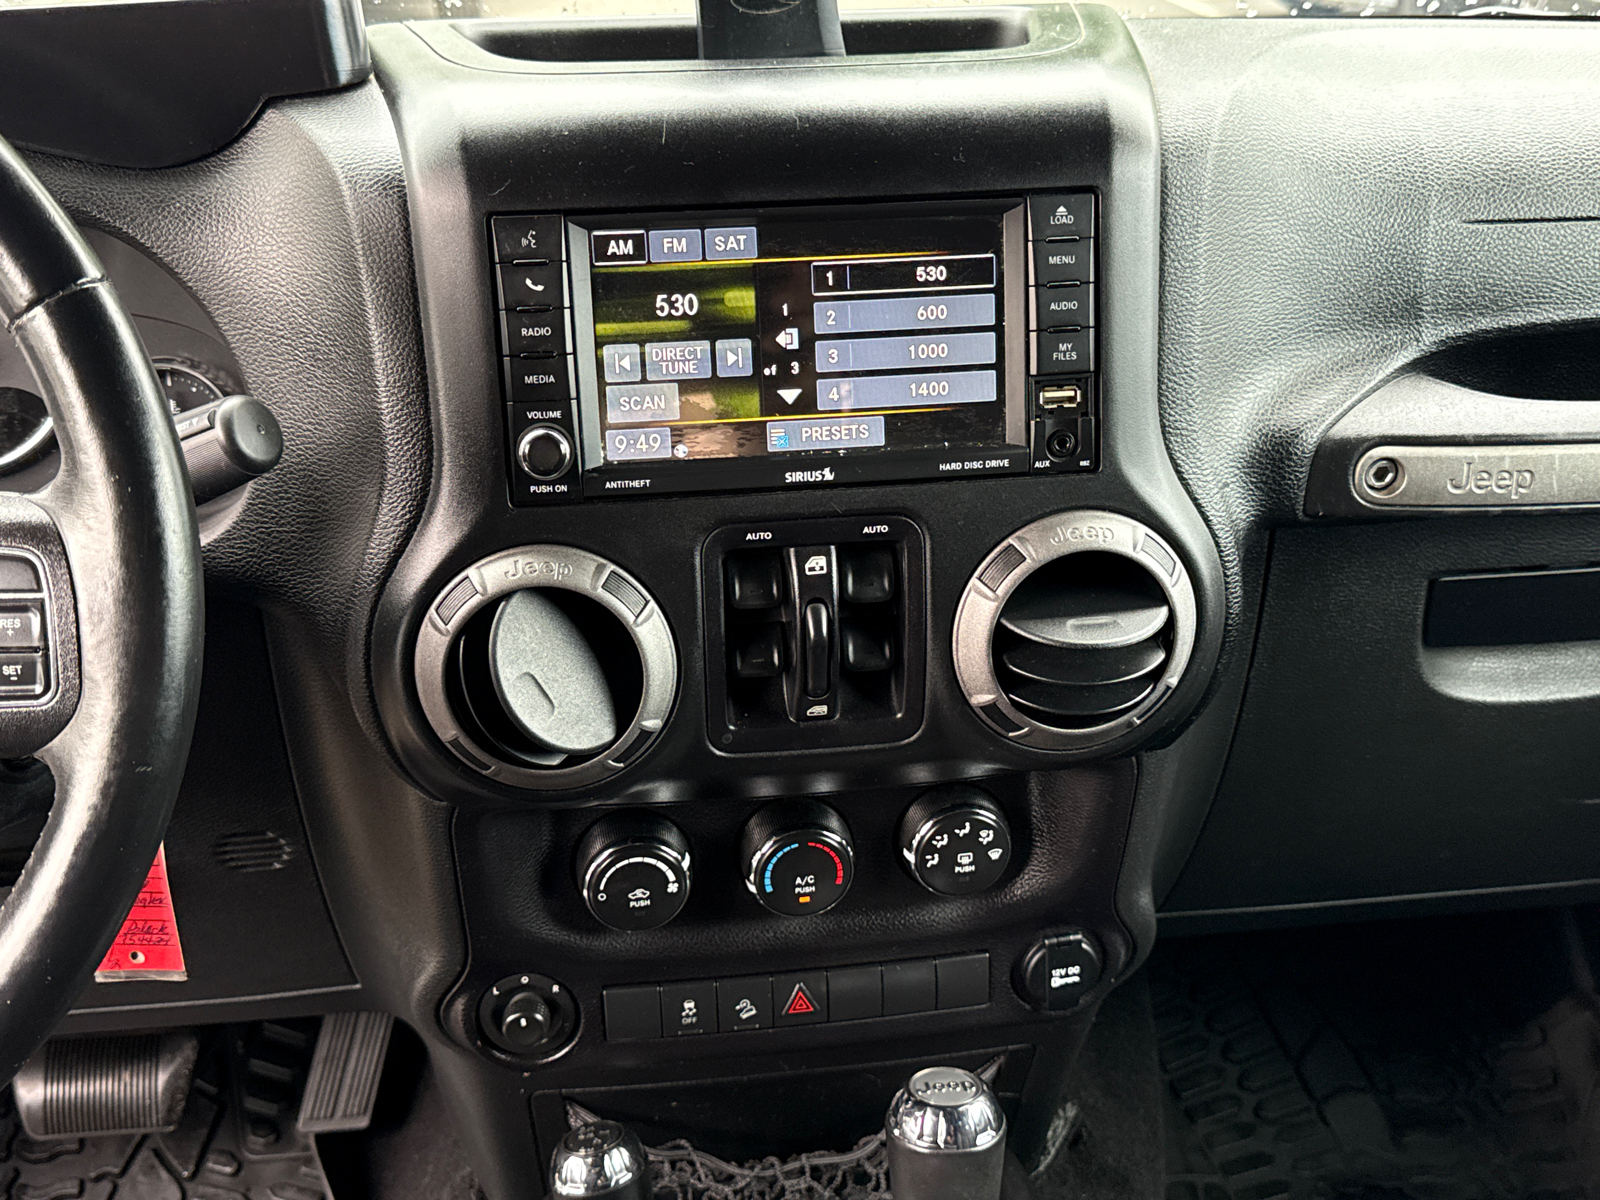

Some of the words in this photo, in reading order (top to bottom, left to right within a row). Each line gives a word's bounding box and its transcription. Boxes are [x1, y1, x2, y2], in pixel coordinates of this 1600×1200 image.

[1050, 215, 1074, 225] LOAD
[606, 239, 634, 256] AM
[662, 237, 687, 254] FM
[714, 234, 747, 251] SAT
[1048, 255, 1076, 265] MENU
[825, 270, 834, 286] 1
[915, 265, 947, 282] 530
[655, 293, 699, 317] 530
[782, 303, 788, 317] 1
[1049, 300, 1078, 310] AUDIO
[826, 309, 836, 325] 2
[917, 304, 947, 321] 600
[521, 327, 552, 336] RADIO
[652, 347, 703, 361] DIRECT
[908, 343, 949, 360] 1000
[1058, 343, 1073, 352] MY
[828, 348, 839, 364] 3
[1053, 351, 1077, 361] FILES
[659, 360, 699, 375] TUNE
[763, 364, 777, 376] of
[790, 361, 800, 375] 3
[524, 375, 556, 384] MEDIA
[828, 386, 840, 402] 4
[909, 381, 949, 397] 1400
[619, 394, 666, 412] SCAN
[526, 410, 562, 419] VOLUME
[801, 423, 870, 443] PRESETS
[614, 433, 662, 454] 9:49
[939, 463, 962, 471] HARD
[964, 461, 984, 470] DISC
[985, 459, 1010, 468] DRIVE
[785, 470, 822, 483] SIRIUS
[1446, 461, 1536, 500] Jeep
[530, 485, 554, 494] PUSH
[554, 484, 568, 493] ON
[604, 479, 651, 490] ANTITHEFT
[745, 531, 773, 541] AUTO
[862, 524, 889, 535] AUTO
[1050, 526, 1115, 545] Jeep
[504, 560, 573, 581] Jeep
[0, 618, 21, 629] RES
[2, 665, 22, 676] SET
[954, 864, 976, 874] PUSH
[795, 874, 815, 886] A/C
[795, 885, 816, 895] PUSH
[629, 899, 651, 908] PUSH
[492, 986, 500, 996] L
[552, 984, 560, 994] R
[682, 1016, 698, 1025] OFF
[915, 1080, 977, 1096] Jeep
